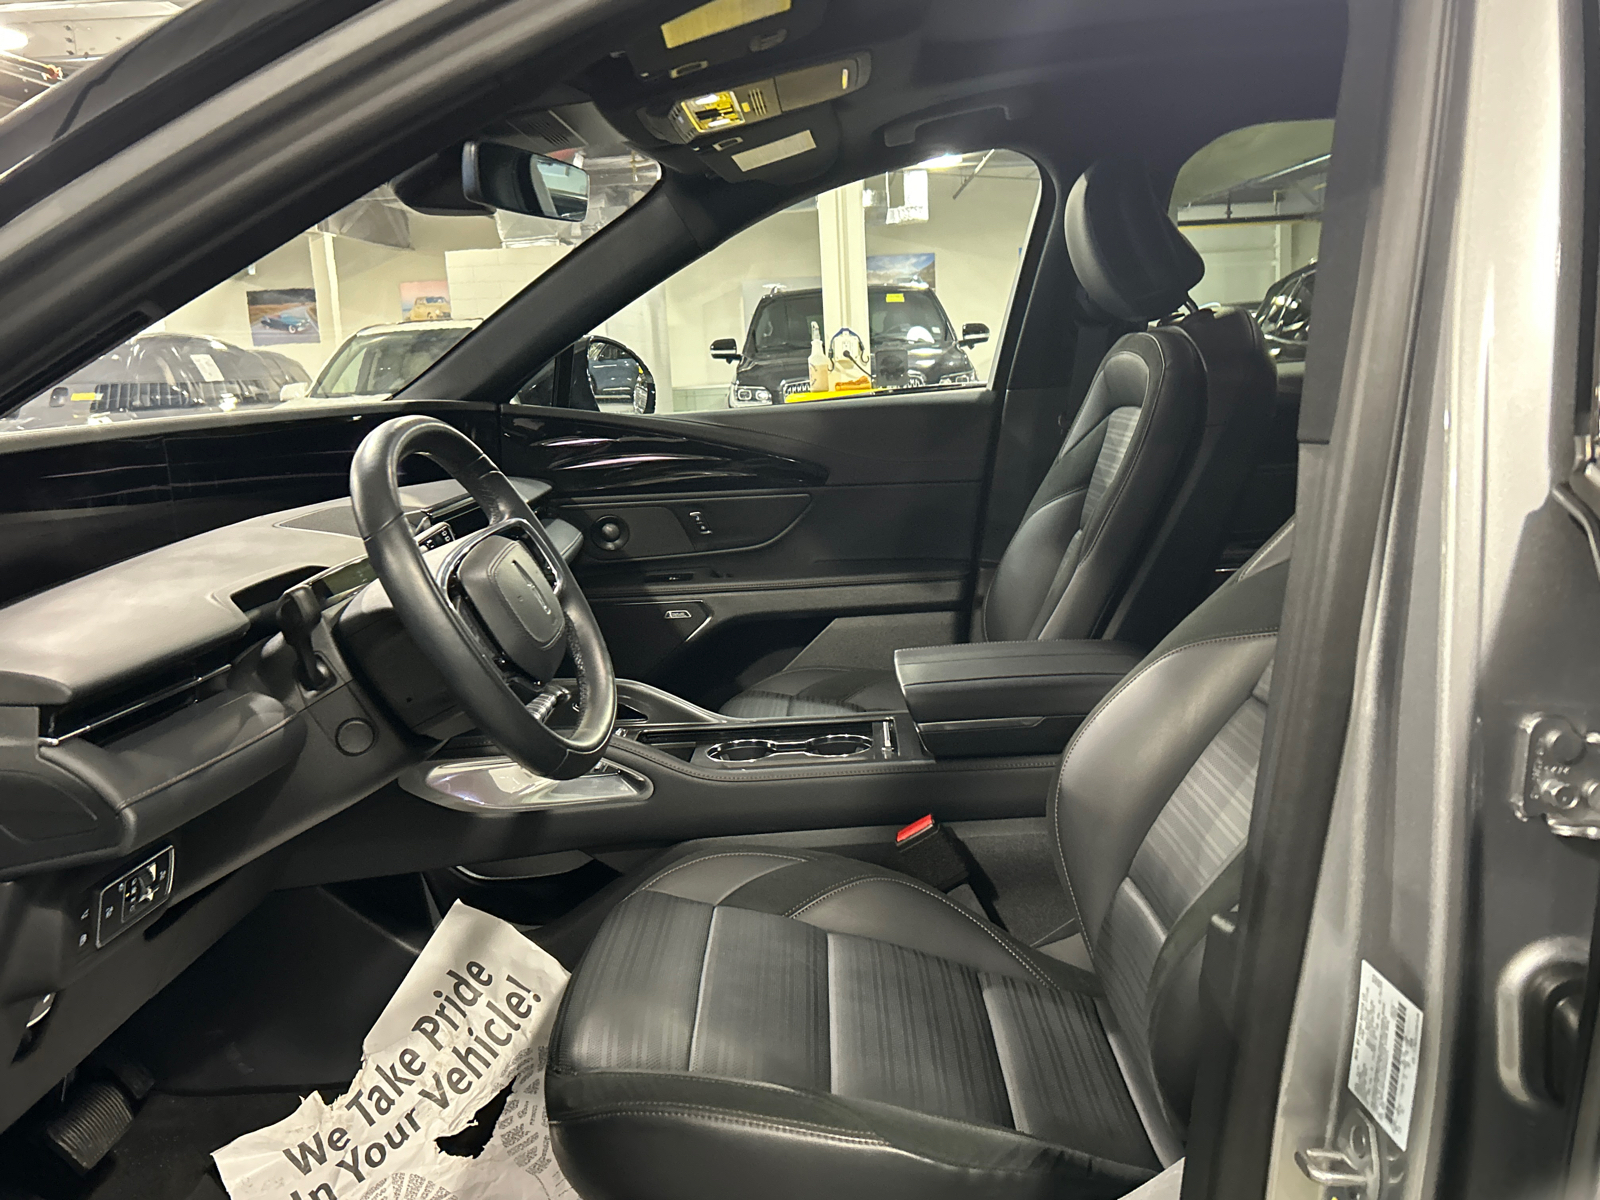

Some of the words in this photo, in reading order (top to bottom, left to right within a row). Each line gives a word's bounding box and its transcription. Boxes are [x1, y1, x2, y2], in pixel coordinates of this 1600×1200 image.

[282, 1127, 351, 1176] We
[345, 1047, 426, 1127] Take
[412, 960, 493, 1052] Pride
[335, 1107, 421, 1183] Your
[418, 974, 542, 1110] Vehicle!
